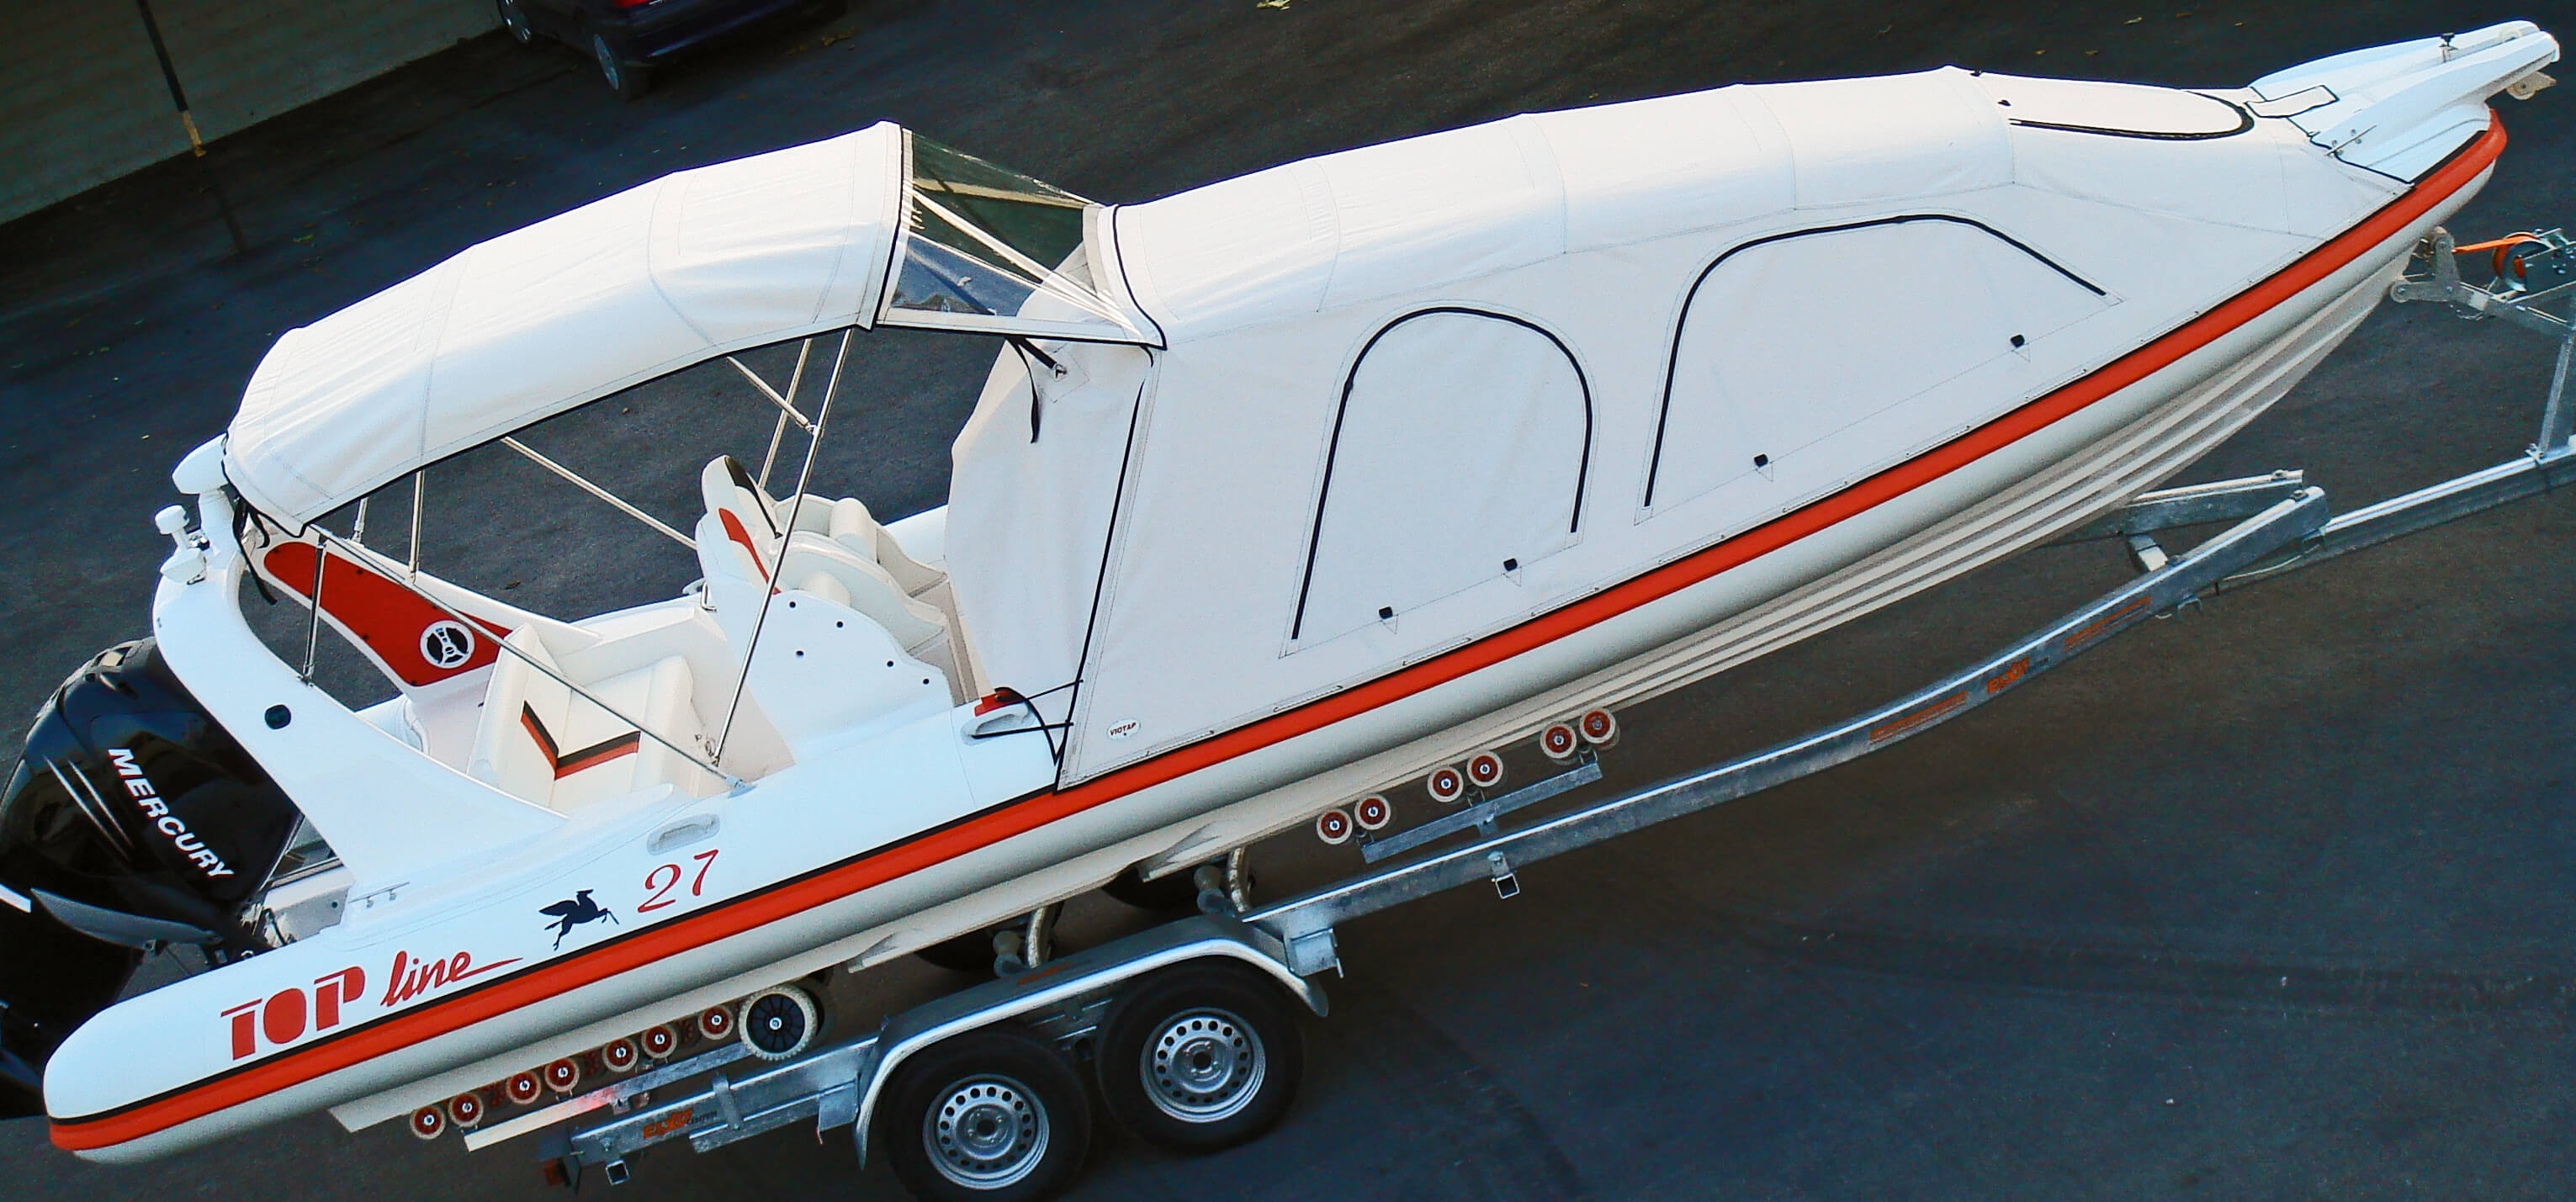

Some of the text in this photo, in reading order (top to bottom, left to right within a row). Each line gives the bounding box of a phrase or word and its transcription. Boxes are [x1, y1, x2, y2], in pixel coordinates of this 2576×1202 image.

[107, 747, 235, 878] MERCURY
[637, 849, 719, 913] 27
[220, 950, 523, 1061] TOP line
